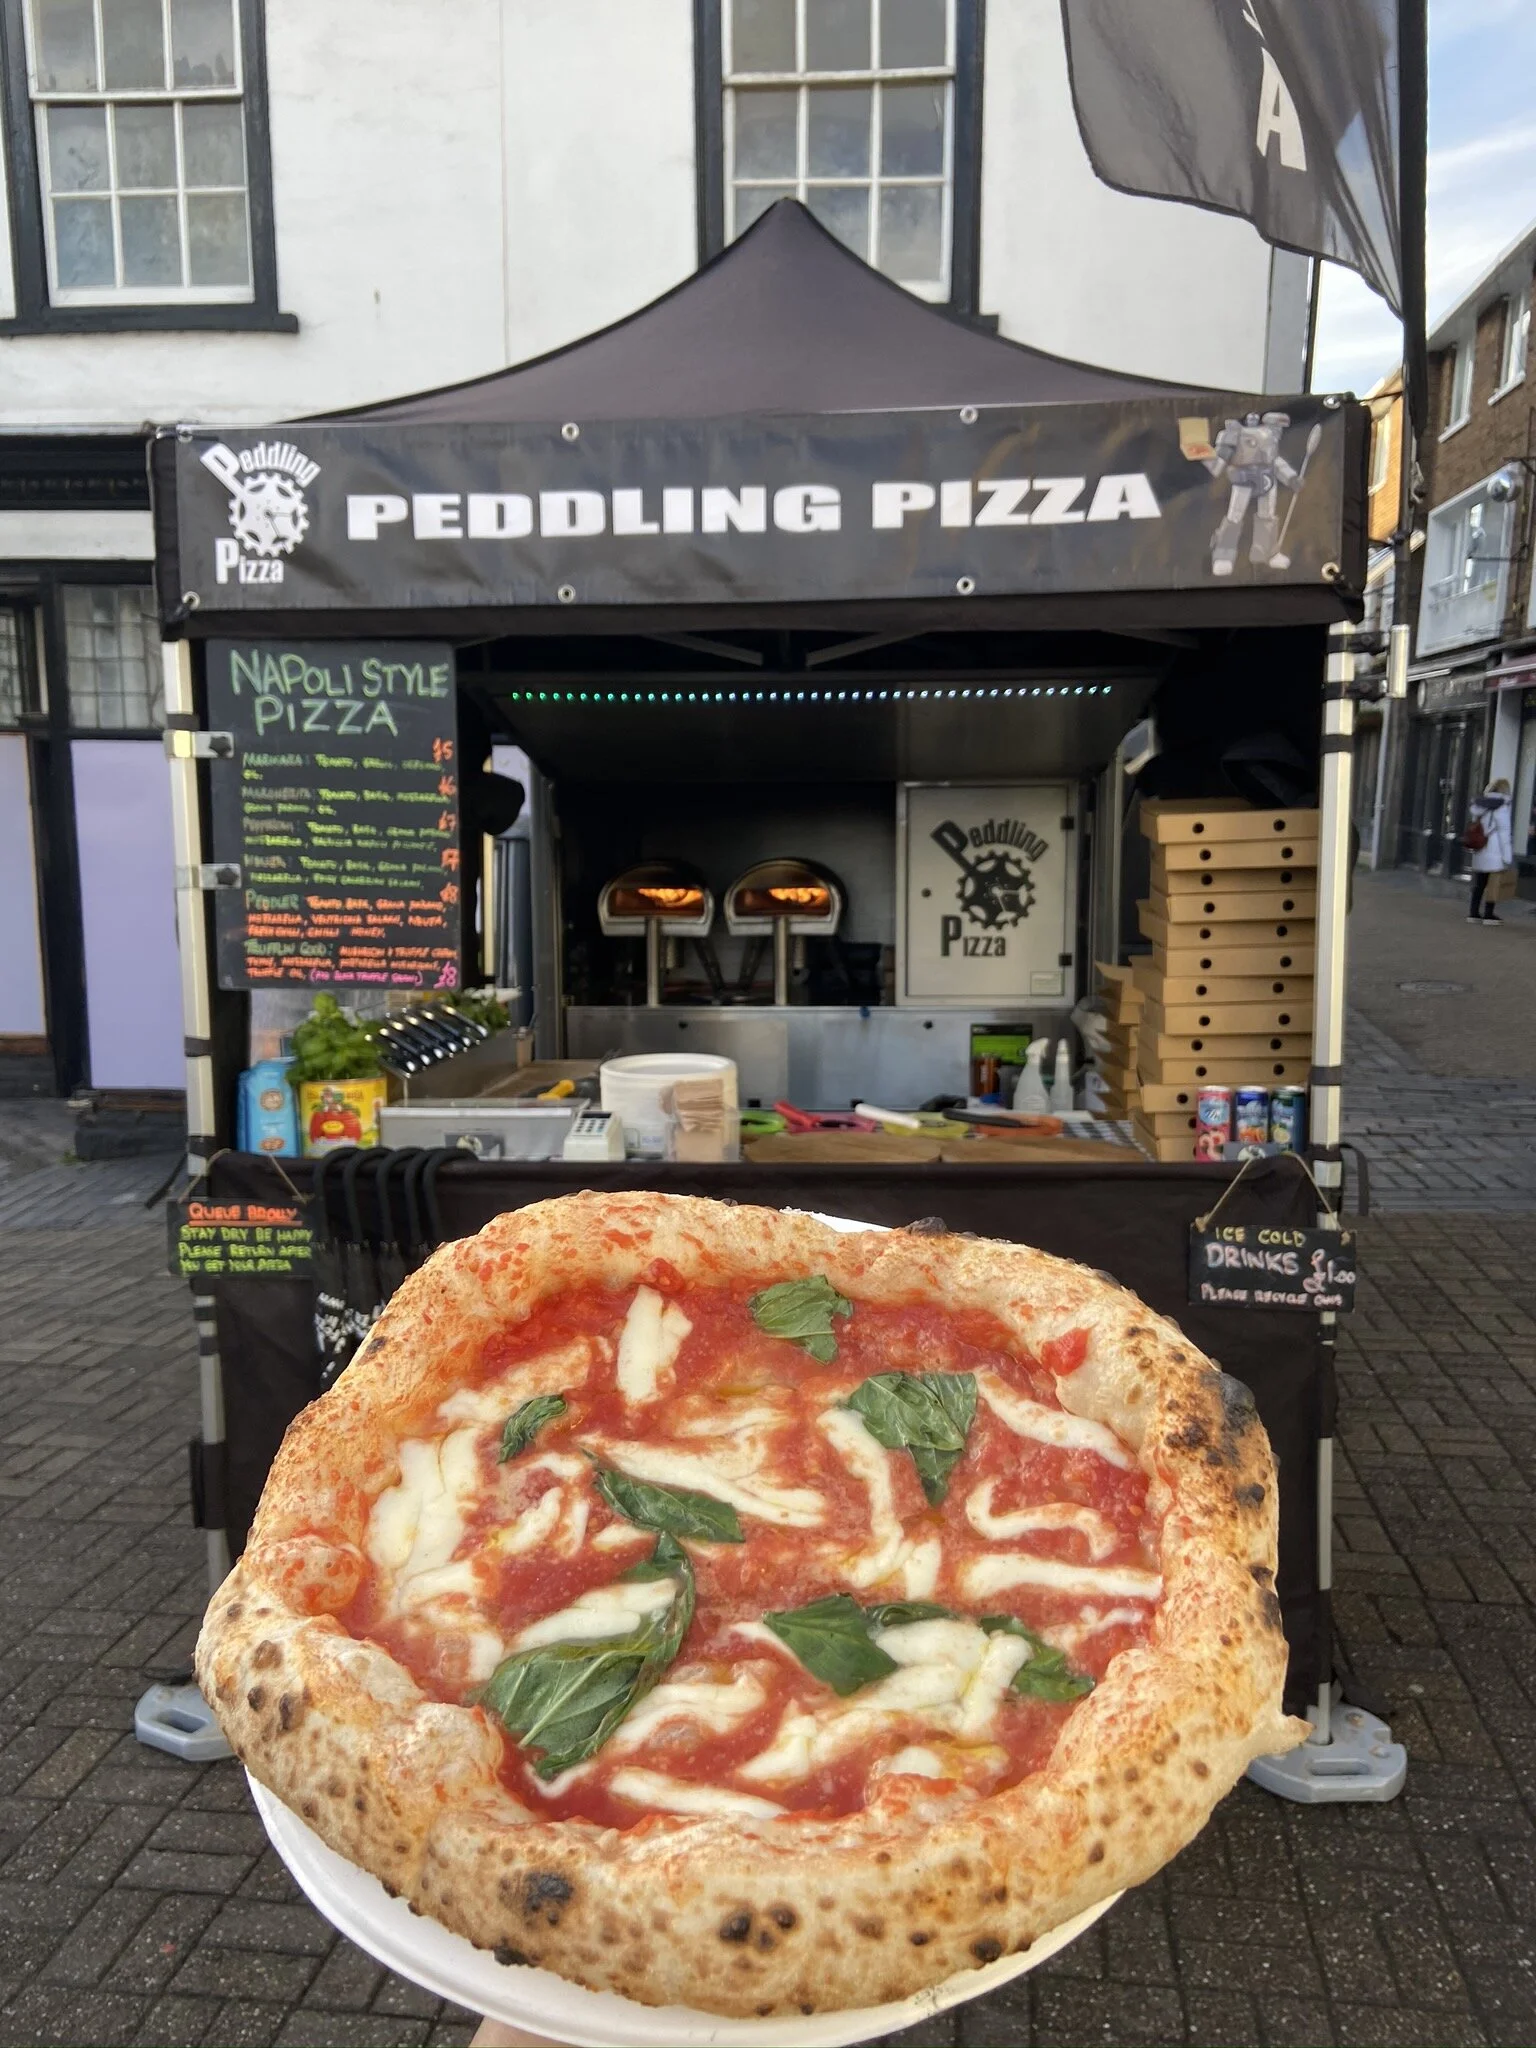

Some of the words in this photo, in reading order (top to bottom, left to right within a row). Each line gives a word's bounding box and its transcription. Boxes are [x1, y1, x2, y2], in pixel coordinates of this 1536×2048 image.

[200, 441, 322, 501] Peddling
[346, 484, 843, 541] PEDDLING
[871, 473, 1162, 529] PIZZA
[215, 538, 285, 585] Pizza
[230, 649, 352, 695] NAPOLI
[361, 657, 449, 698] STYLE
[930, 818, 1049, 872] Peddling
[941, 915, 1006, 957] Pizza
[255, 1227, 272, 1242] BE
[1215, 1227, 1246, 1242] ICE
[1258, 1228, 1307, 1247] COLD
[1205, 1242, 1299, 1276] DRINKS
